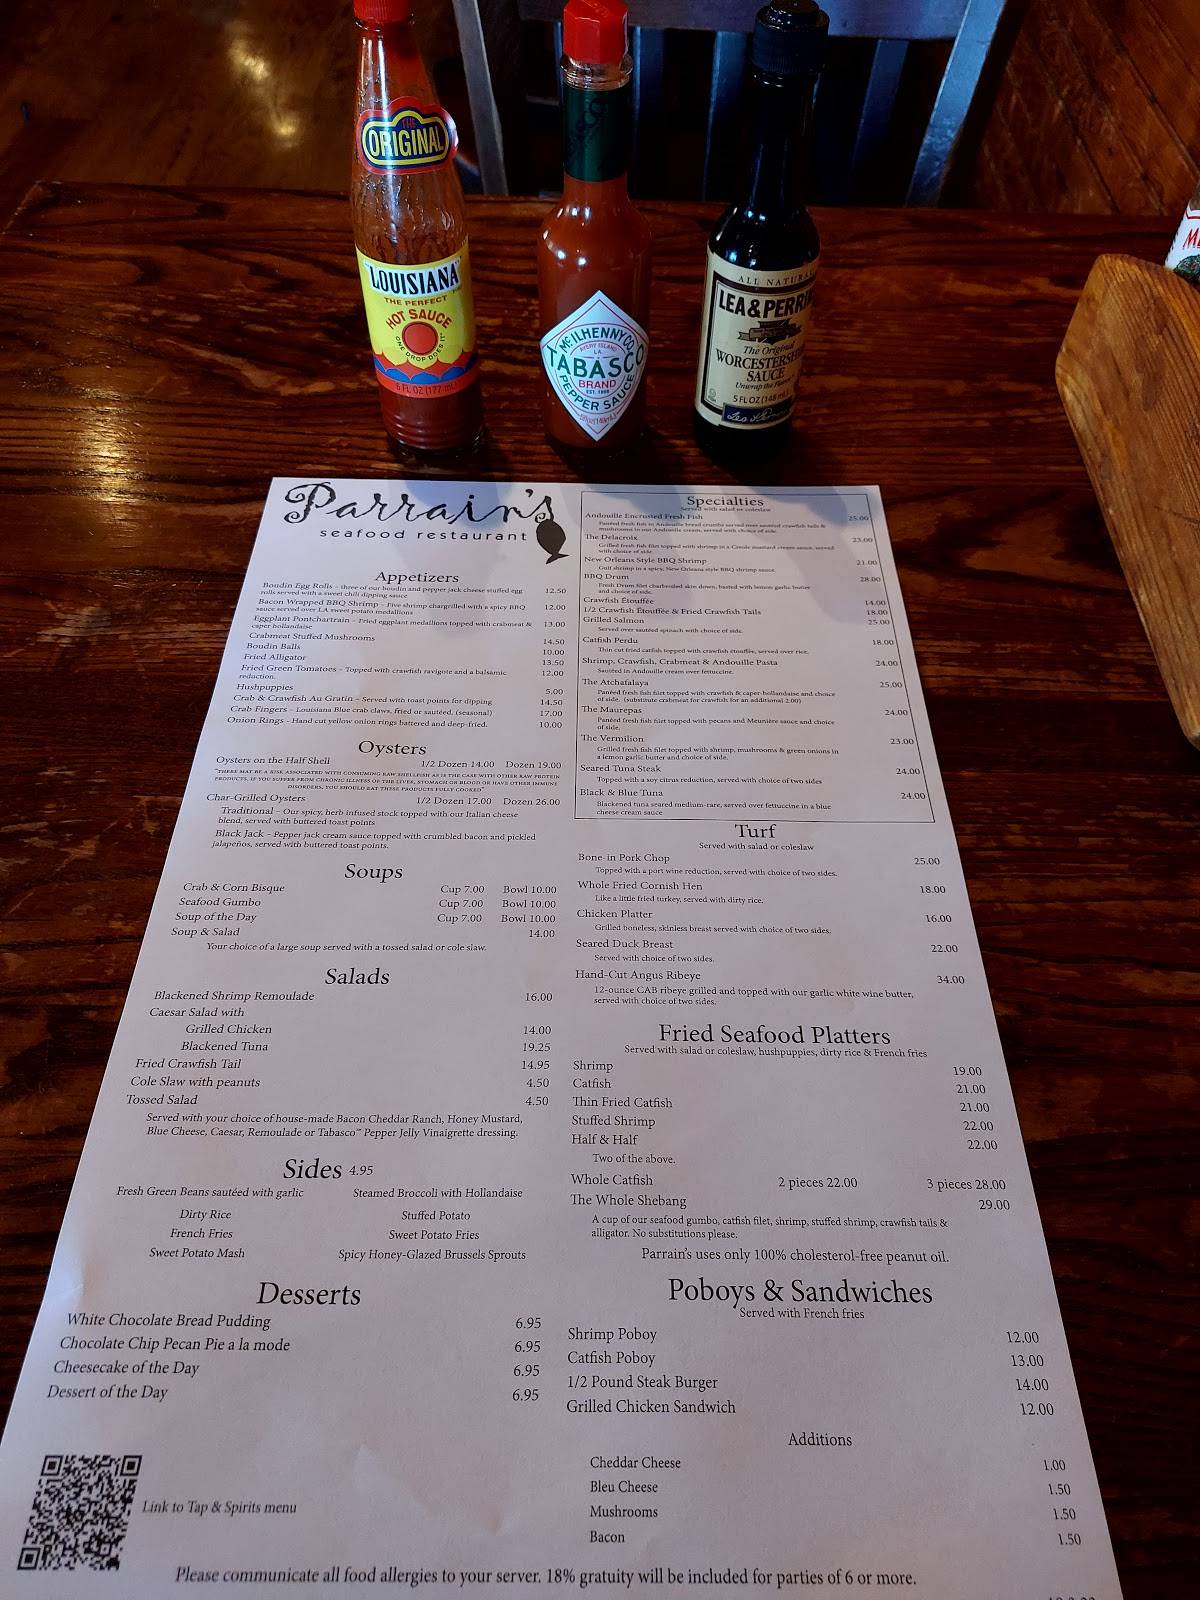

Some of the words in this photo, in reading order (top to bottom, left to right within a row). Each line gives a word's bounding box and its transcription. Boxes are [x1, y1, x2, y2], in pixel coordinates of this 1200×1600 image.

[368, 126, 444, 156] ORIGINAL
[1182, 226, 1200, 250] M
[738, 275, 759, 285] ALL
[384, 297, 402, 305] THE
[405, 295, 447, 306] PERFECT
[386, 310, 406, 330] HOT
[408, 308, 452, 329] SAUCE
[395, 335, 404, 351] ONE
[405, 351, 426, 362] DROP
[428, 343, 444, 360] DOES
[743, 344, 761, 355] The
[546, 344, 645, 379] TABASCO
[746, 367, 785, 383] SAUCE
[578, 380, 617, 389] BRAND
[559, 374, 600, 411] PEPPER
[603, 374, 635, 410] SAUCE
[733, 394, 738, 403] 5
[739, 395, 748, 404] FL
[749, 394, 761, 404] OZ
[283, 481, 557, 525] Parrain's
[687, 496, 764, 508] Specialties
[320, 529, 405, 539] seafood
[417, 531, 526, 541] restaurant
[375, 571, 459, 585] Appetizers
[248, 632, 291, 641] Crabmeat
[292, 632, 323, 640] Stuffed
[543, 638, 567, 646] 14.50
[236, 683, 294, 693] Hushpuppies
[358, 740, 426, 758] Oysters
[206, 793, 268, 803] Char-Grilled
[269, 794, 306, 804] Oysters
[416, 796, 431, 804] 1/2
[433, 797, 463, 805] Dozen
[467, 797, 492, 806] 17.00
[503, 797, 533, 806] Dozen
[535, 798, 560, 806] 26.00
[734, 823, 777, 838] Turf
[579, 853, 616, 861] Bone-in
[619, 853, 642, 863] Pork
[643, 853, 670, 864] Chop
[914, 857, 940, 865] 25.00
[344, 863, 403, 883] Soups
[178, 896, 220, 908] Seafood
[222, 897, 261, 907] Gumbo
[439, 899, 461, 910] Cup
[463, 899, 483, 908] 7.00
[502, 899, 527, 910] Bowl
[529, 899, 556, 909] 10.00
[594, 954, 621, 962] Served
[622, 954, 638, 962] with
[641, 954, 666, 962] choice
[667, 954, 677, 962] of
[325, 967, 390, 985] Salads
[154, 990, 209, 1000] Blackened
[211, 991, 251, 1003] Shrimp
[254, 991, 315, 1001] Remoulade
[525, 992, 553, 1002] 16.00
[659, 1023, 715, 1042] Fried
[721, 1024, 805, 1044] Seafood
[810, 1026, 890, 1045] Platters
[283, 1157, 342, 1179] Sides
[349, 1165, 373, 1176] 4.95
[570, 1173, 609, 1185] Whole
[612, 1173, 653, 1186] Catfish
[778, 1177, 785, 1187] 2
[788, 1177, 824, 1191] pieces
[826, 1177, 858, 1188] 22.00
[927, 1178, 934, 1189] 3
[937, 1178, 973, 1192] pieces
[975, 1179, 1006, 1190] 28.00
[338, 1249, 366, 1262] Spicy
[368, 1248, 442, 1262] Honey-Glazed
[444, 1248, 486, 1260] Brussels
[488, 1249, 526, 1263] Sprouts
[256, 1282, 361, 1305] Desserts
[668, 1277, 755, 1309] Poboys
[763, 1279, 784, 1302] &
[791, 1278, 932, 1303] Sandwiches
[68, 1312, 105, 1326] White
[109, 1313, 173, 1326] Chocolate
[176, 1313, 213, 1327] Bread
[216, 1314, 271, 1332] Pudding
[515, 1317, 541, 1330] 6.95
[568, 1375, 588, 1388] 1/2
[591, 1374, 634, 1388] Pound
[637, 1374, 672, 1388] Steak
[674, 1375, 718, 1393] Burger
[1016, 1378, 1049, 1391] 14.00
[788, 1431, 852, 1446] Additions
[590, 1480, 615, 1493] Bleu
[618, 1480, 658, 1493] Cheese
[1048, 1483, 1071, 1495] 1.50
[142, 1500, 169, 1513] Link
[172, 1502, 184, 1513] to
[188, 1500, 208, 1517] Tap
[211, 1501, 222, 1513] &
[224, 1501, 261, 1517] Spirits
[264, 1504, 297, 1514] menu
[176, 1566, 219, 1582] Please
[223, 1568, 319, 1583] communicate
[323, 1566, 340, 1583] all
[344, 1566, 376, 1583] food
[380, 1566, 438, 1589] allergies
[442, 1569, 456, 1583] to
[460, 1572, 493, 1588] your
[496, 1572, 540, 1583] server.
[546, 1568, 576, 1584] 18%
[579, 1567, 635, 1589] gratuity
[638, 1567, 664, 1584] will
[668, 1567, 685, 1584] be
[688, 1567, 748, 1584] included
[753, 1567, 773, 1584] for
[777, 1568, 824, 1589] parties
[827, 1567, 843, 1584] of
[845, 1570, 854, 1585] 6
[857, 1573, 872, 1585] or
[876, 1573, 917, 1585] more.
